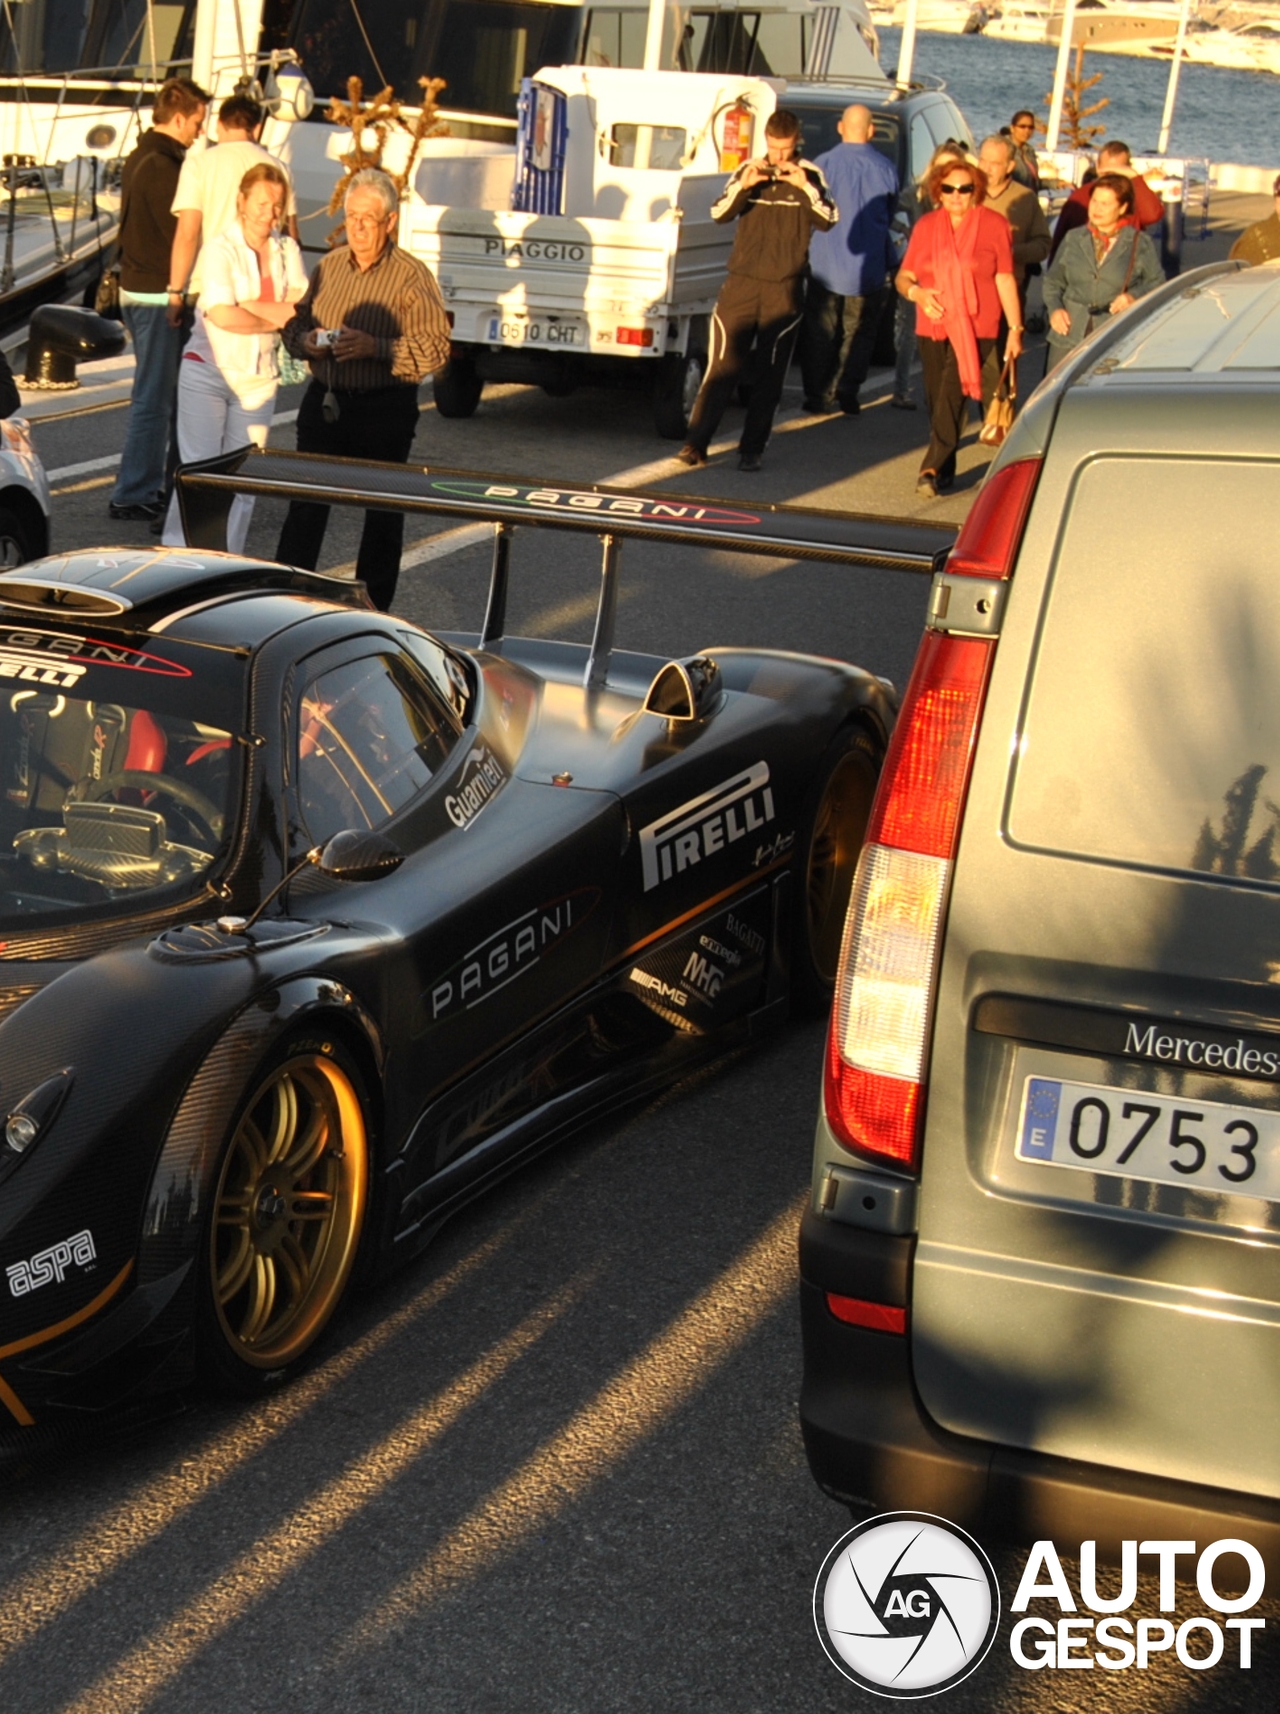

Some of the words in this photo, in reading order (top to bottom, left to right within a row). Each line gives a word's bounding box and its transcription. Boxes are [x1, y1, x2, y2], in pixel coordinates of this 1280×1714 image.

[484, 239, 585, 262] PIAGGIO
[500, 322, 540, 342] 0610
[547, 325, 578, 343] CHT
[485, 486, 707, 519] PAGANI
[445, 747, 504, 828] Guarnieri
[639, 760, 776, 893] PIRELLI
[432, 900, 573, 1019] PAGANI
[646, 975, 688, 1007] AMG
[1030, 1127, 1047, 1147] E
[1069, 1096, 1259, 1182] 0753
[6, 1229, 97, 1297] aspa
